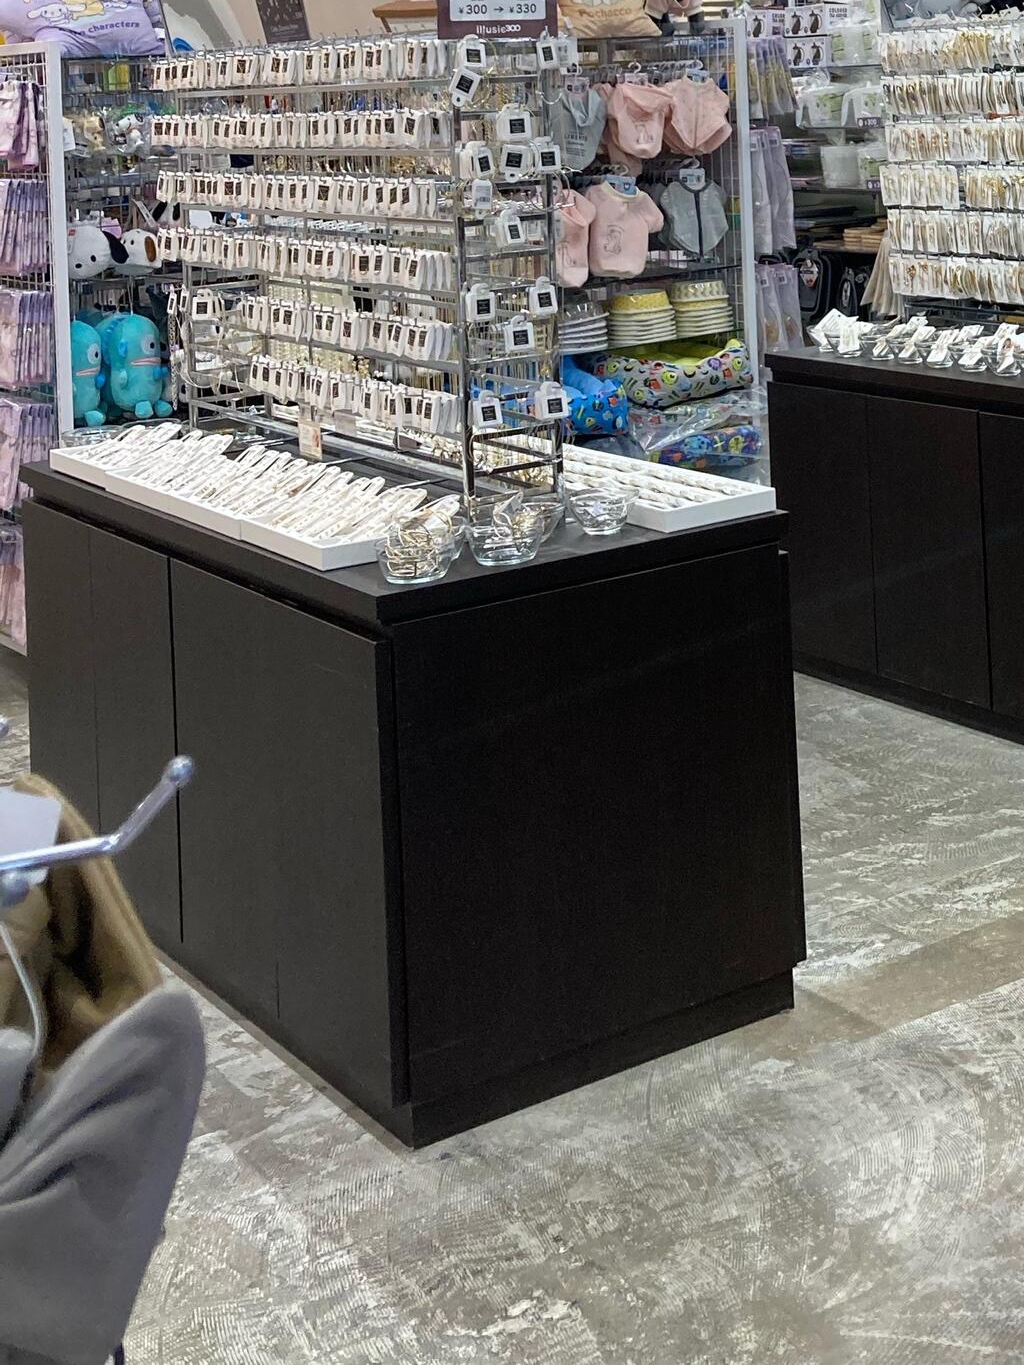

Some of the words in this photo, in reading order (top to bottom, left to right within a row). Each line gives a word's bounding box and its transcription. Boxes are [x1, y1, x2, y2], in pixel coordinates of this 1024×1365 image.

[459, 4, 488, 15] ¥300
[509, 3, 537, 14] ¥330
[88, 20, 140, 33] characters
